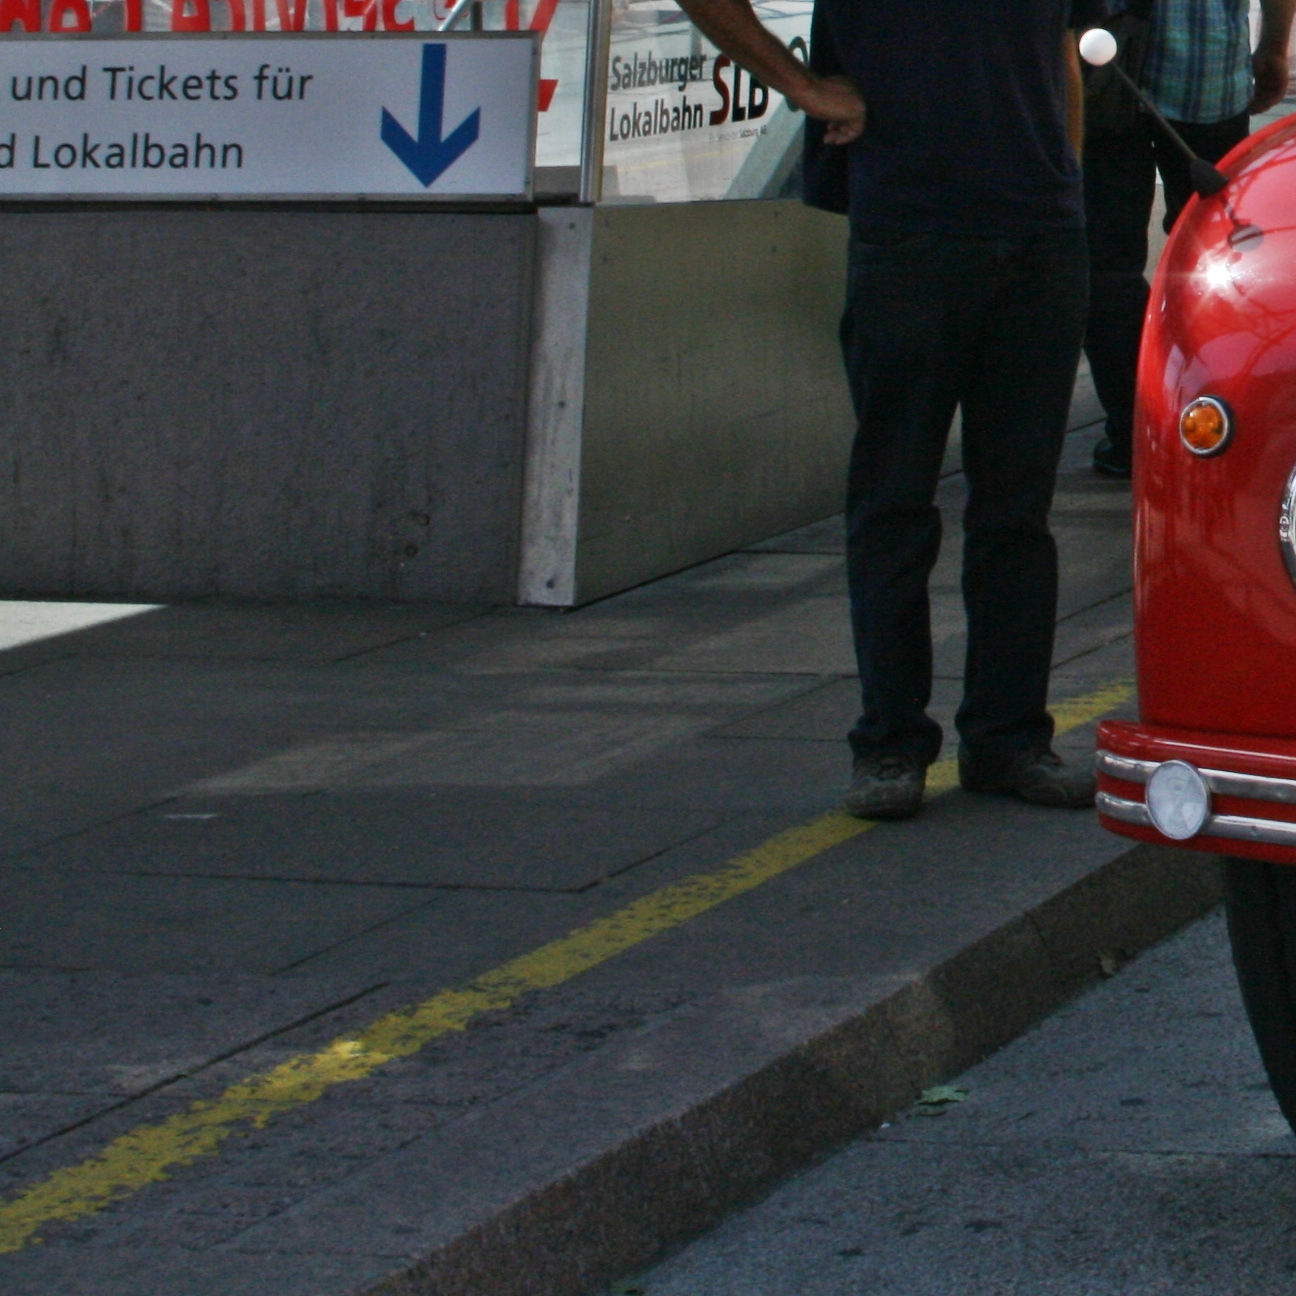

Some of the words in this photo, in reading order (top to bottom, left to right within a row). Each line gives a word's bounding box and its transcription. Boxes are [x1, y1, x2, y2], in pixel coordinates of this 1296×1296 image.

[11, 64, 87, 101] und
[102, 64, 239, 101] Tickets
[253, 63, 314, 101] für
[610, 51, 707, 92] Salzburger
[609, 95, 704, 142] Lokalbahn
[33, 133, 244, 169] Lokalbahn
